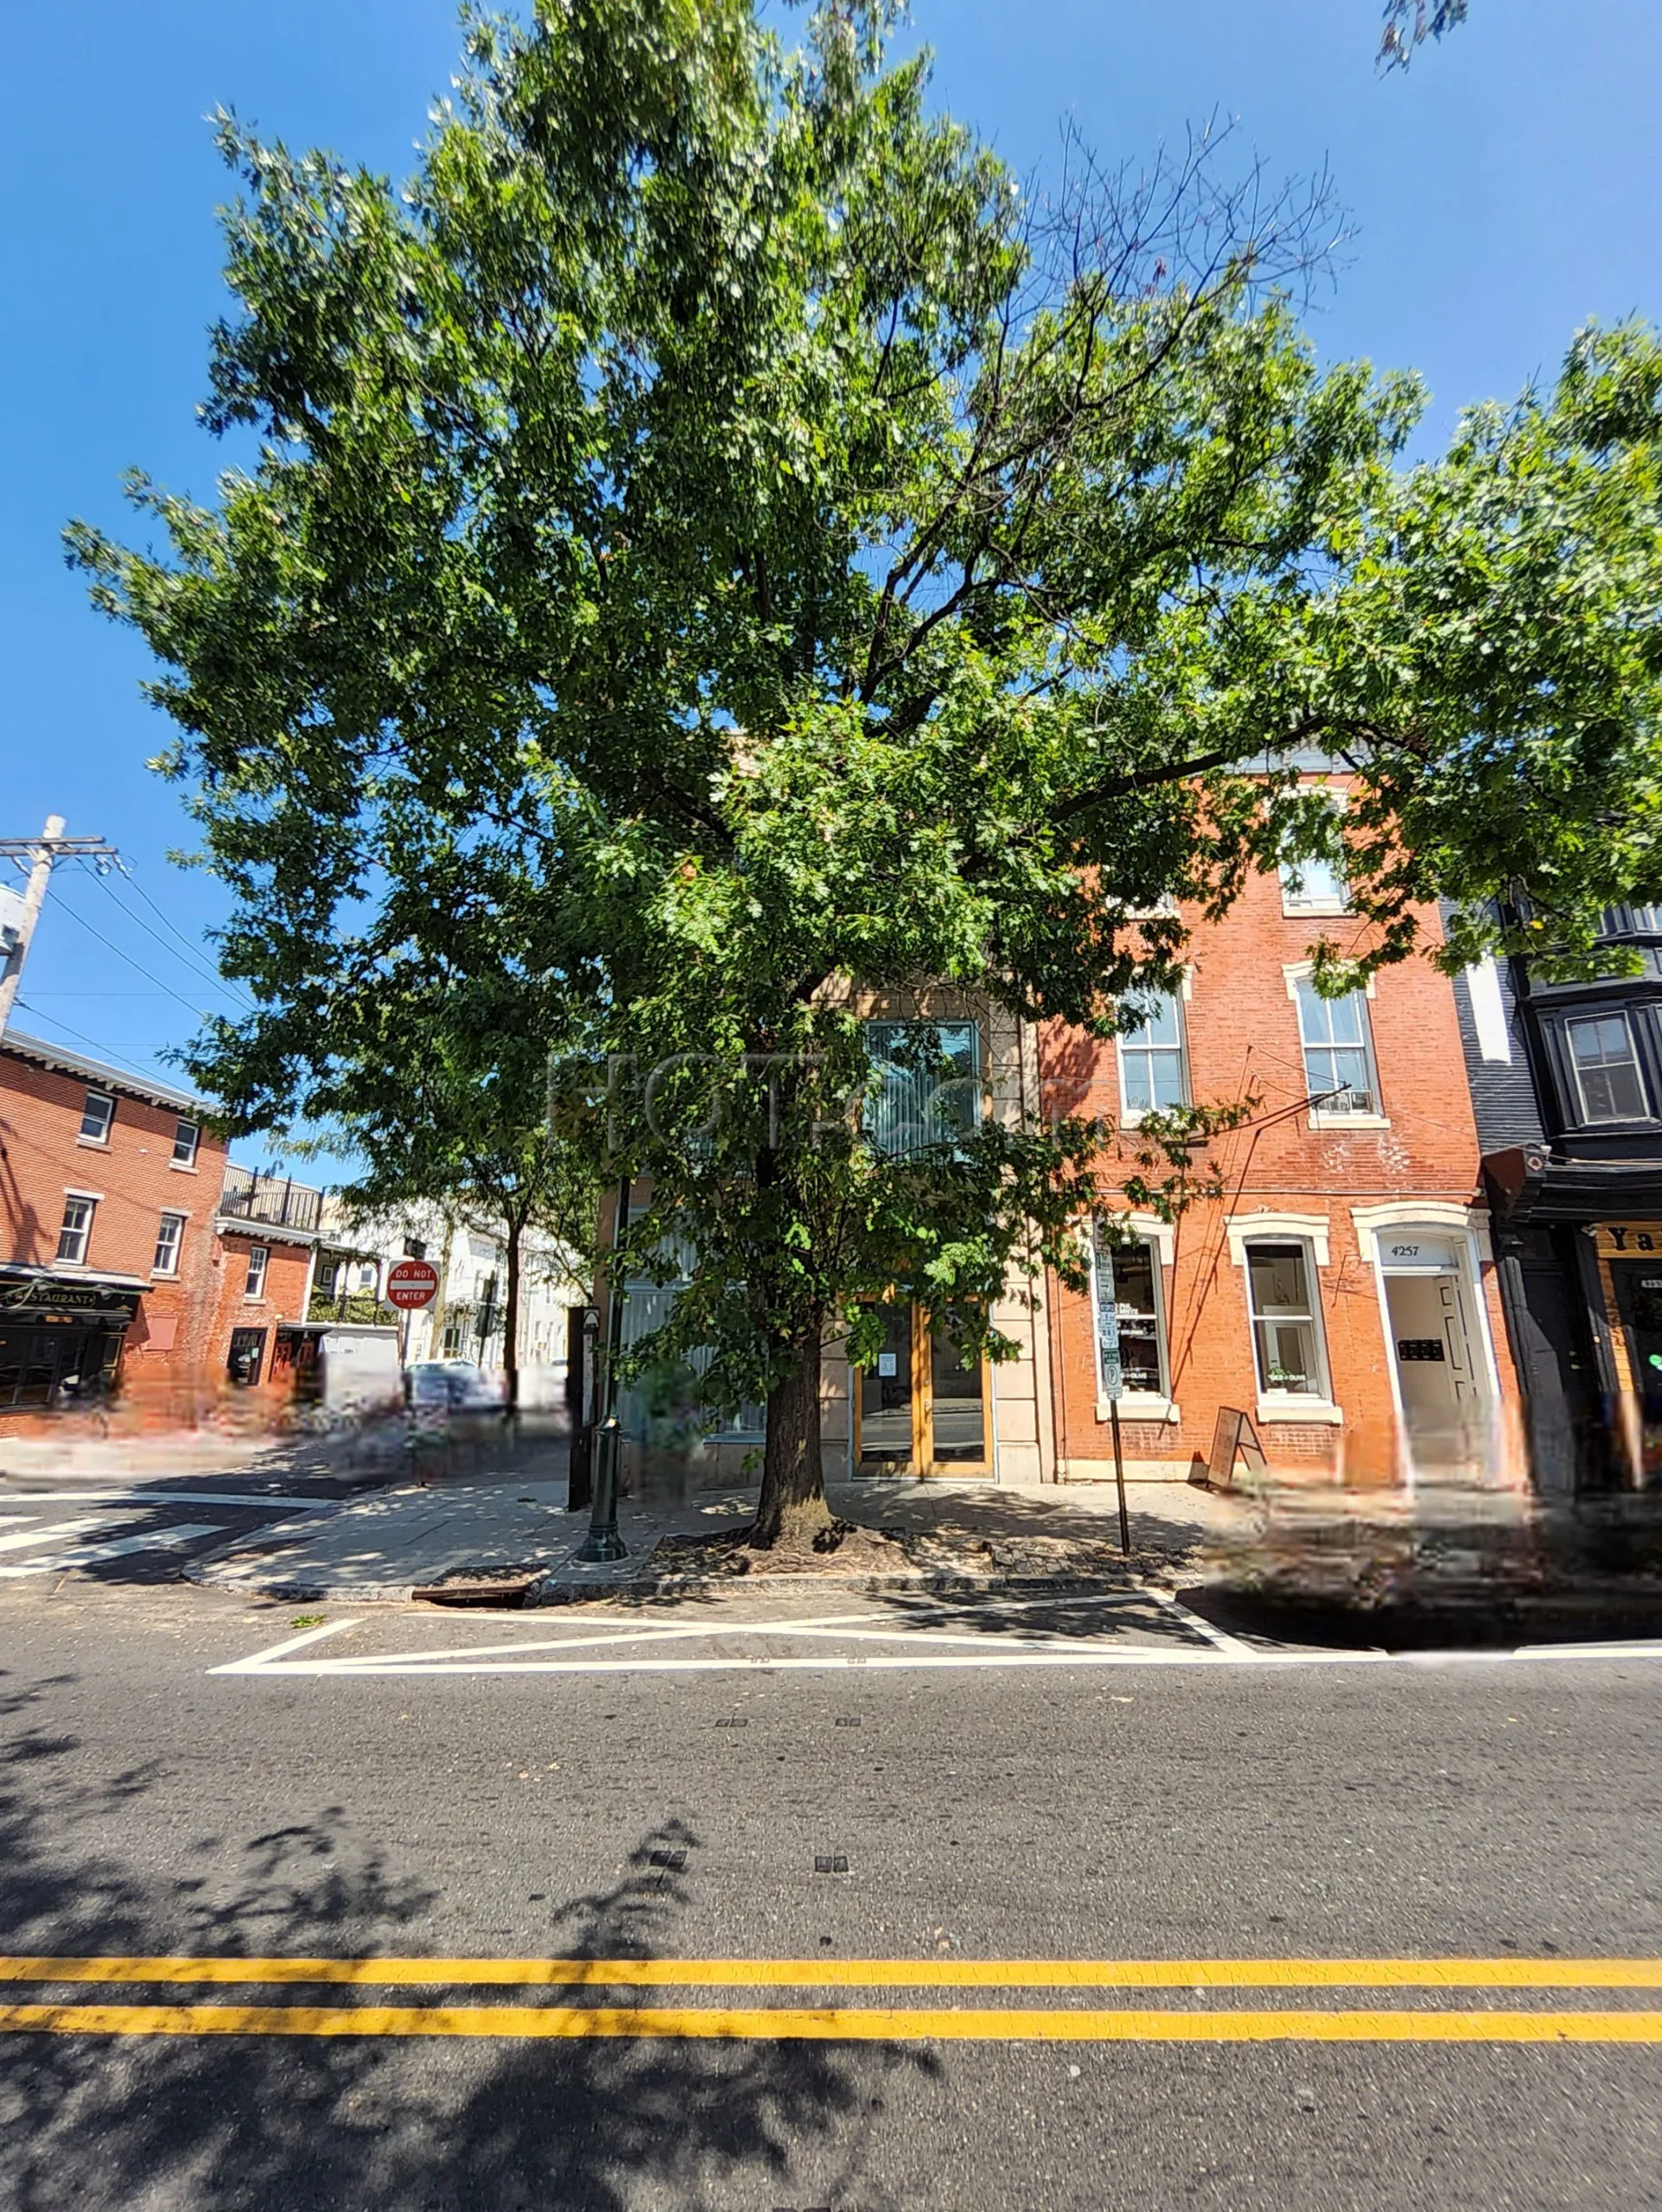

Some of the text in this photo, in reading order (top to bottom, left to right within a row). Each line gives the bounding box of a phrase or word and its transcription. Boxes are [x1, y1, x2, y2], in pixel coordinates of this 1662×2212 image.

[1608, 1226, 1662, 1251] Ya
[1391, 1245, 1419, 1256] 4257
[396, 1269, 431, 1278] DO NOT
[15, 1292, 90, 1305] RSTAURANT
[396, 1292, 425, 1300] ENTER
